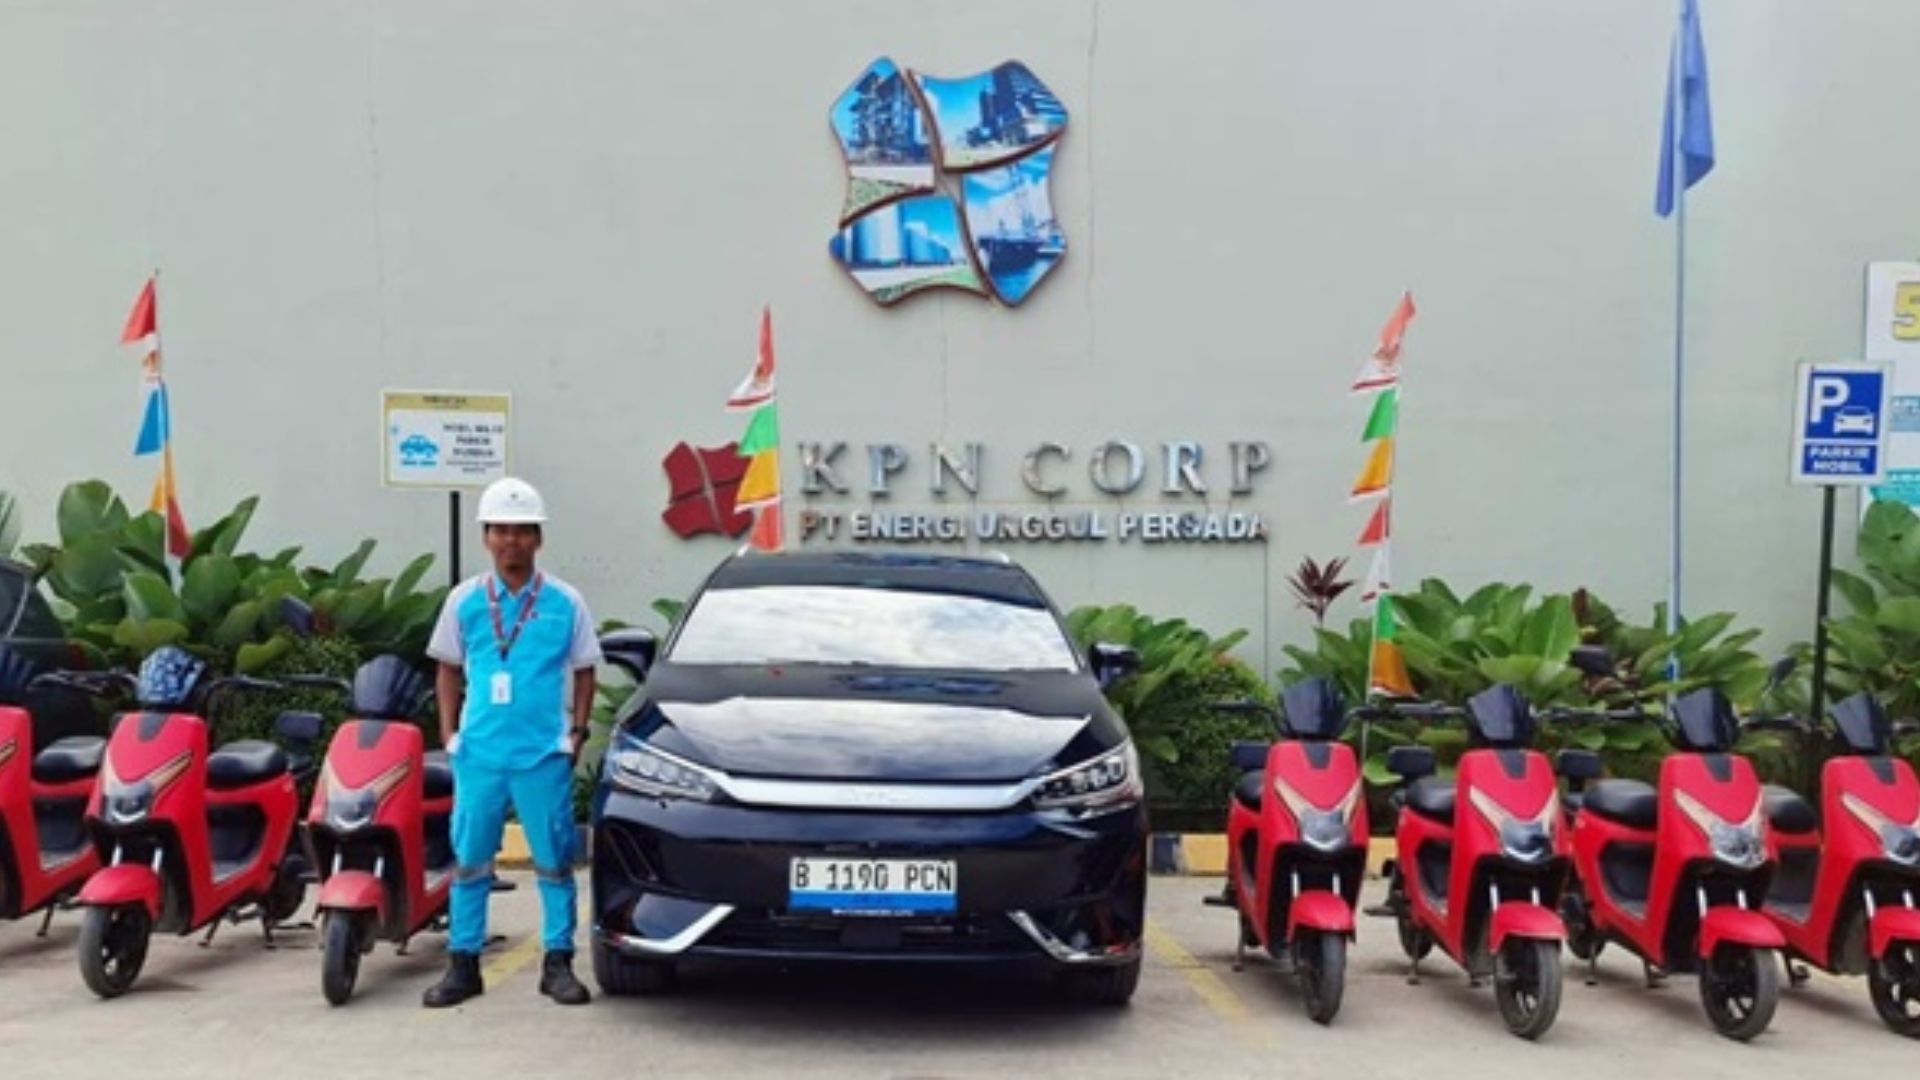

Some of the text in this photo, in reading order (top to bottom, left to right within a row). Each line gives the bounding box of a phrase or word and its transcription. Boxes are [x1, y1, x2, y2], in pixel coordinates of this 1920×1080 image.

[1811, 378, 1850, 424] P
[1809, 446, 1871, 459] PARKIR
[1813, 460, 1863, 473] MOBIL
[798, 440, 1271, 498] KPN CORP
[800, 510, 1270, 543] PT ENERGI UNGGUL PERSADA
[795, 862, 952, 892] B 1190 PCN
